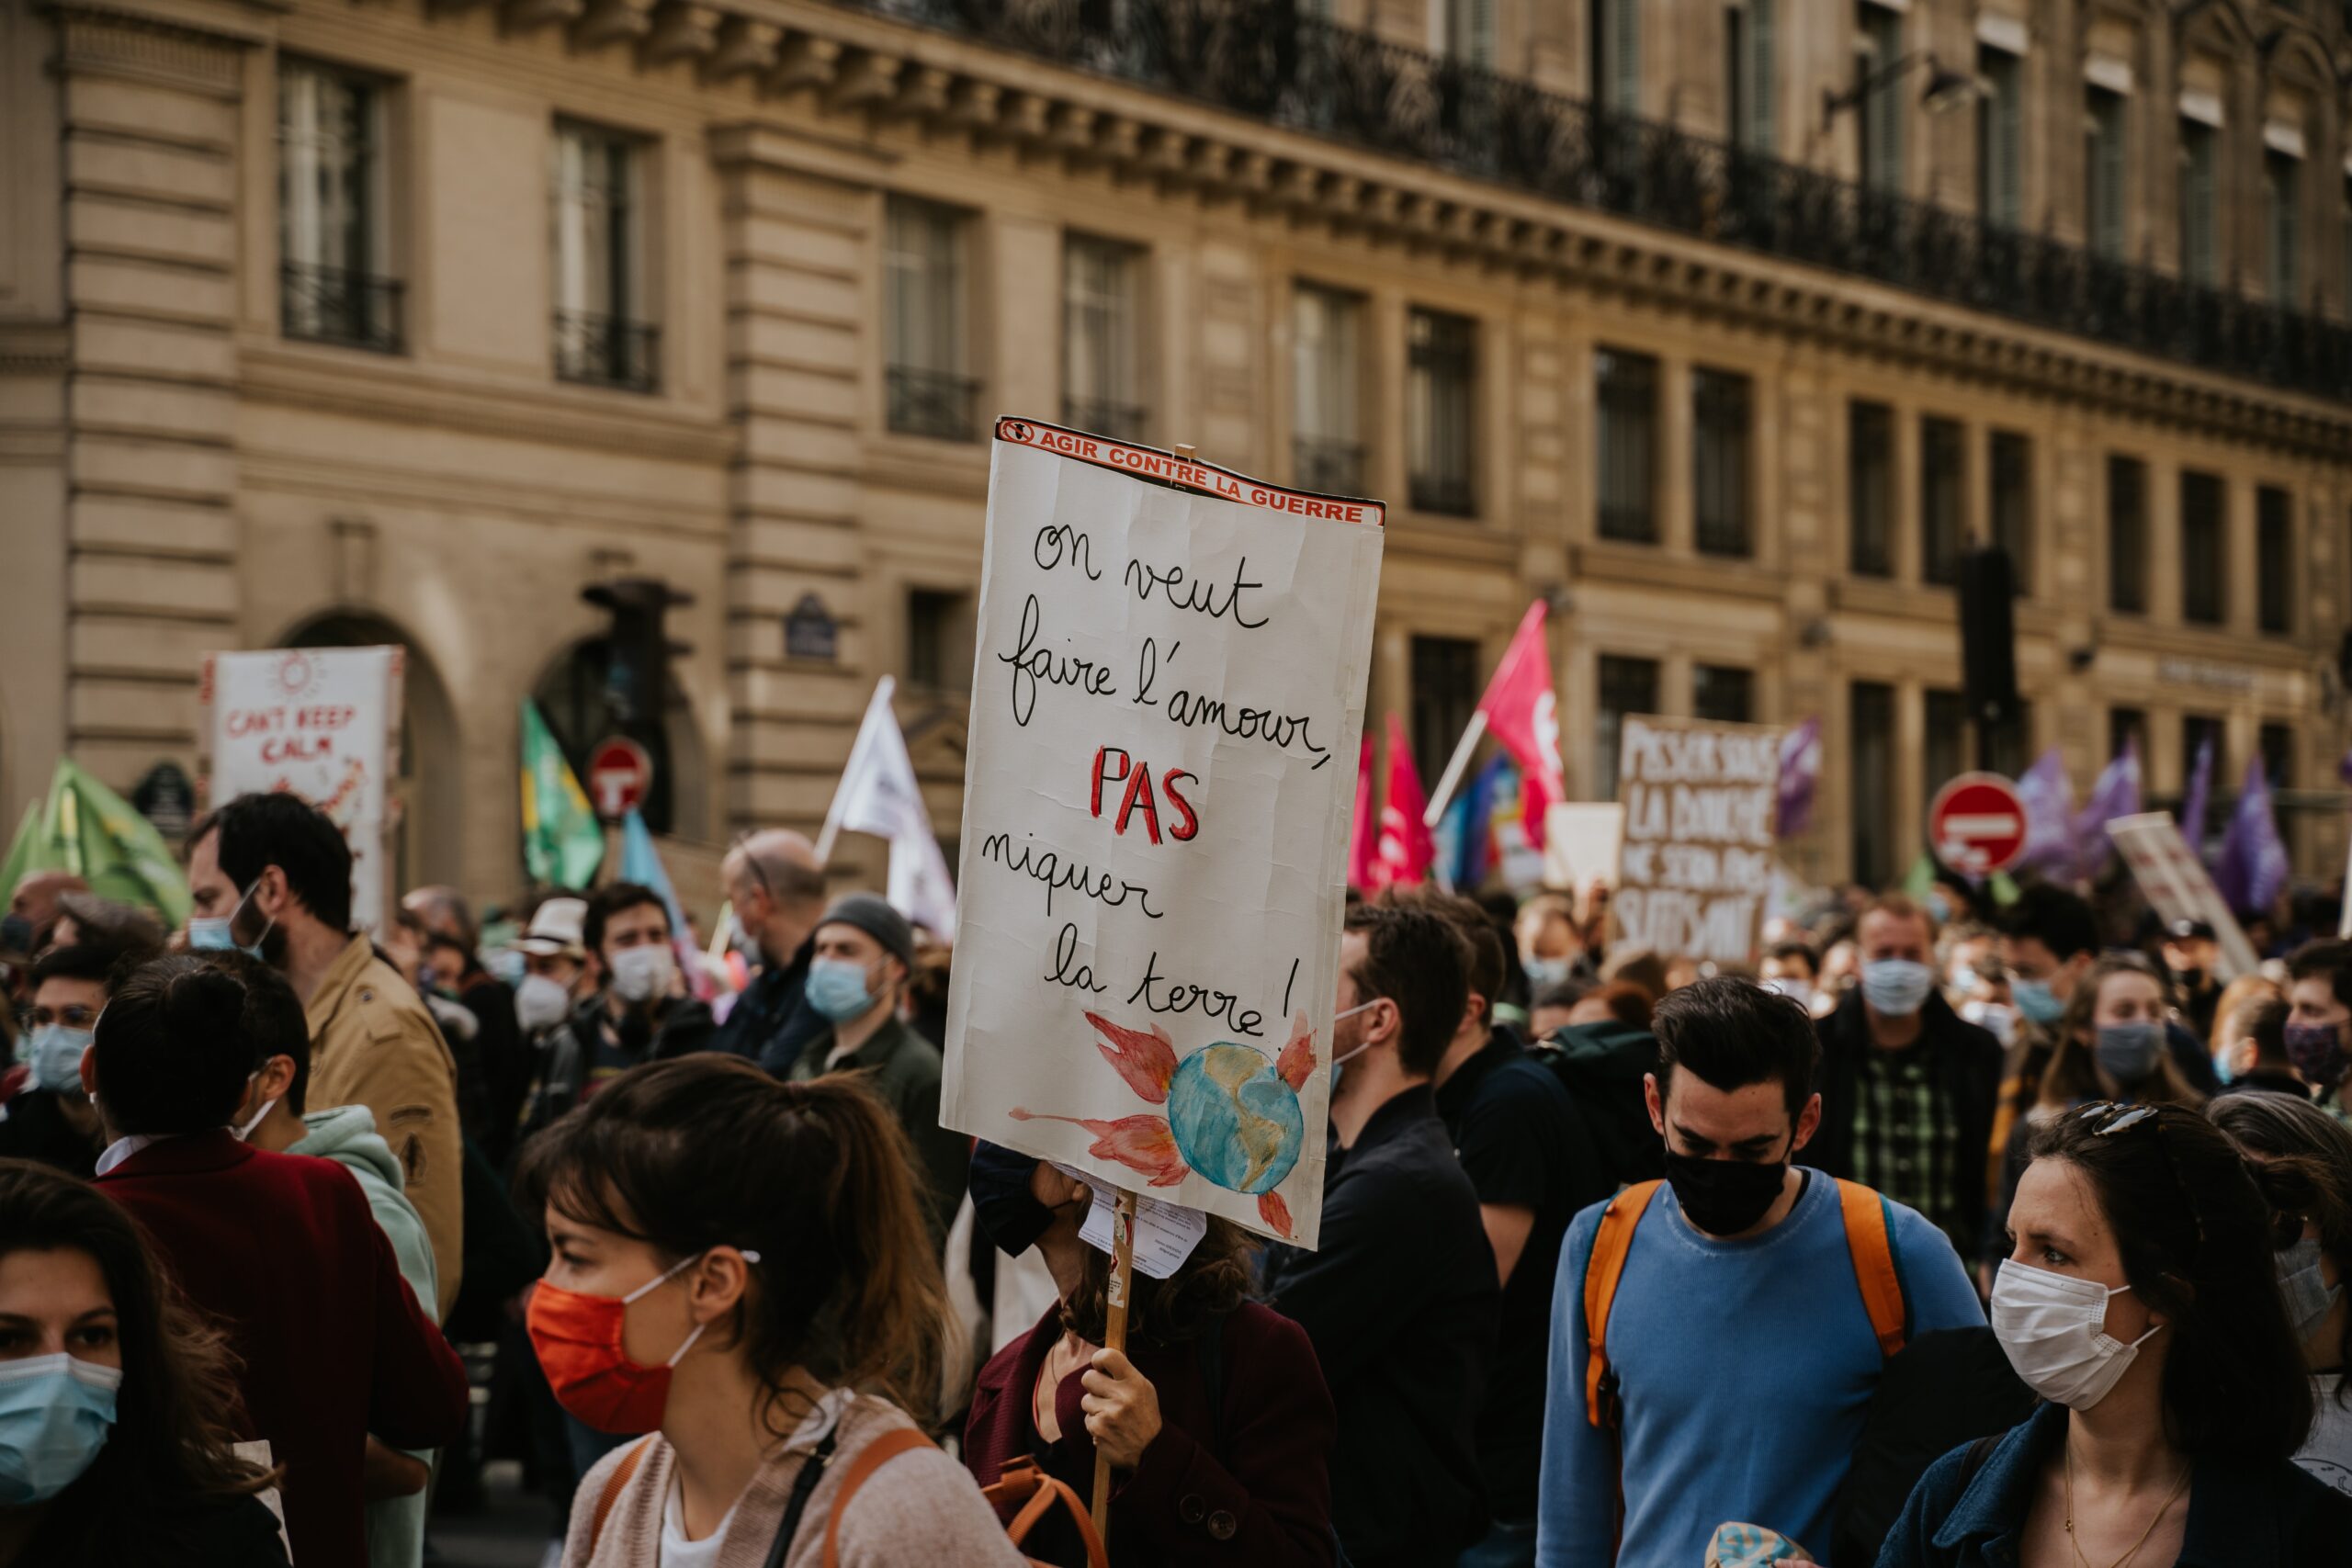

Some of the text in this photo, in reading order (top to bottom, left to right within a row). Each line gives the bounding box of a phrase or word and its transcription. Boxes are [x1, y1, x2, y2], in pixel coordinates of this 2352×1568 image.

[1040, 432, 1363, 524] AGIR CONTRE LA GUERRE
[1035, 525, 1270, 629] on veut
[998, 593, 1116, 728] faire
[260, 737, 334, 765] CALM
[297, 705, 356, 730] KEEP
[1091, 745, 1200, 846] PAS
[1627, 783, 1667, 840] LA
[982, 832, 1164, 918] niquer
[1044, 922, 1108, 993] la
